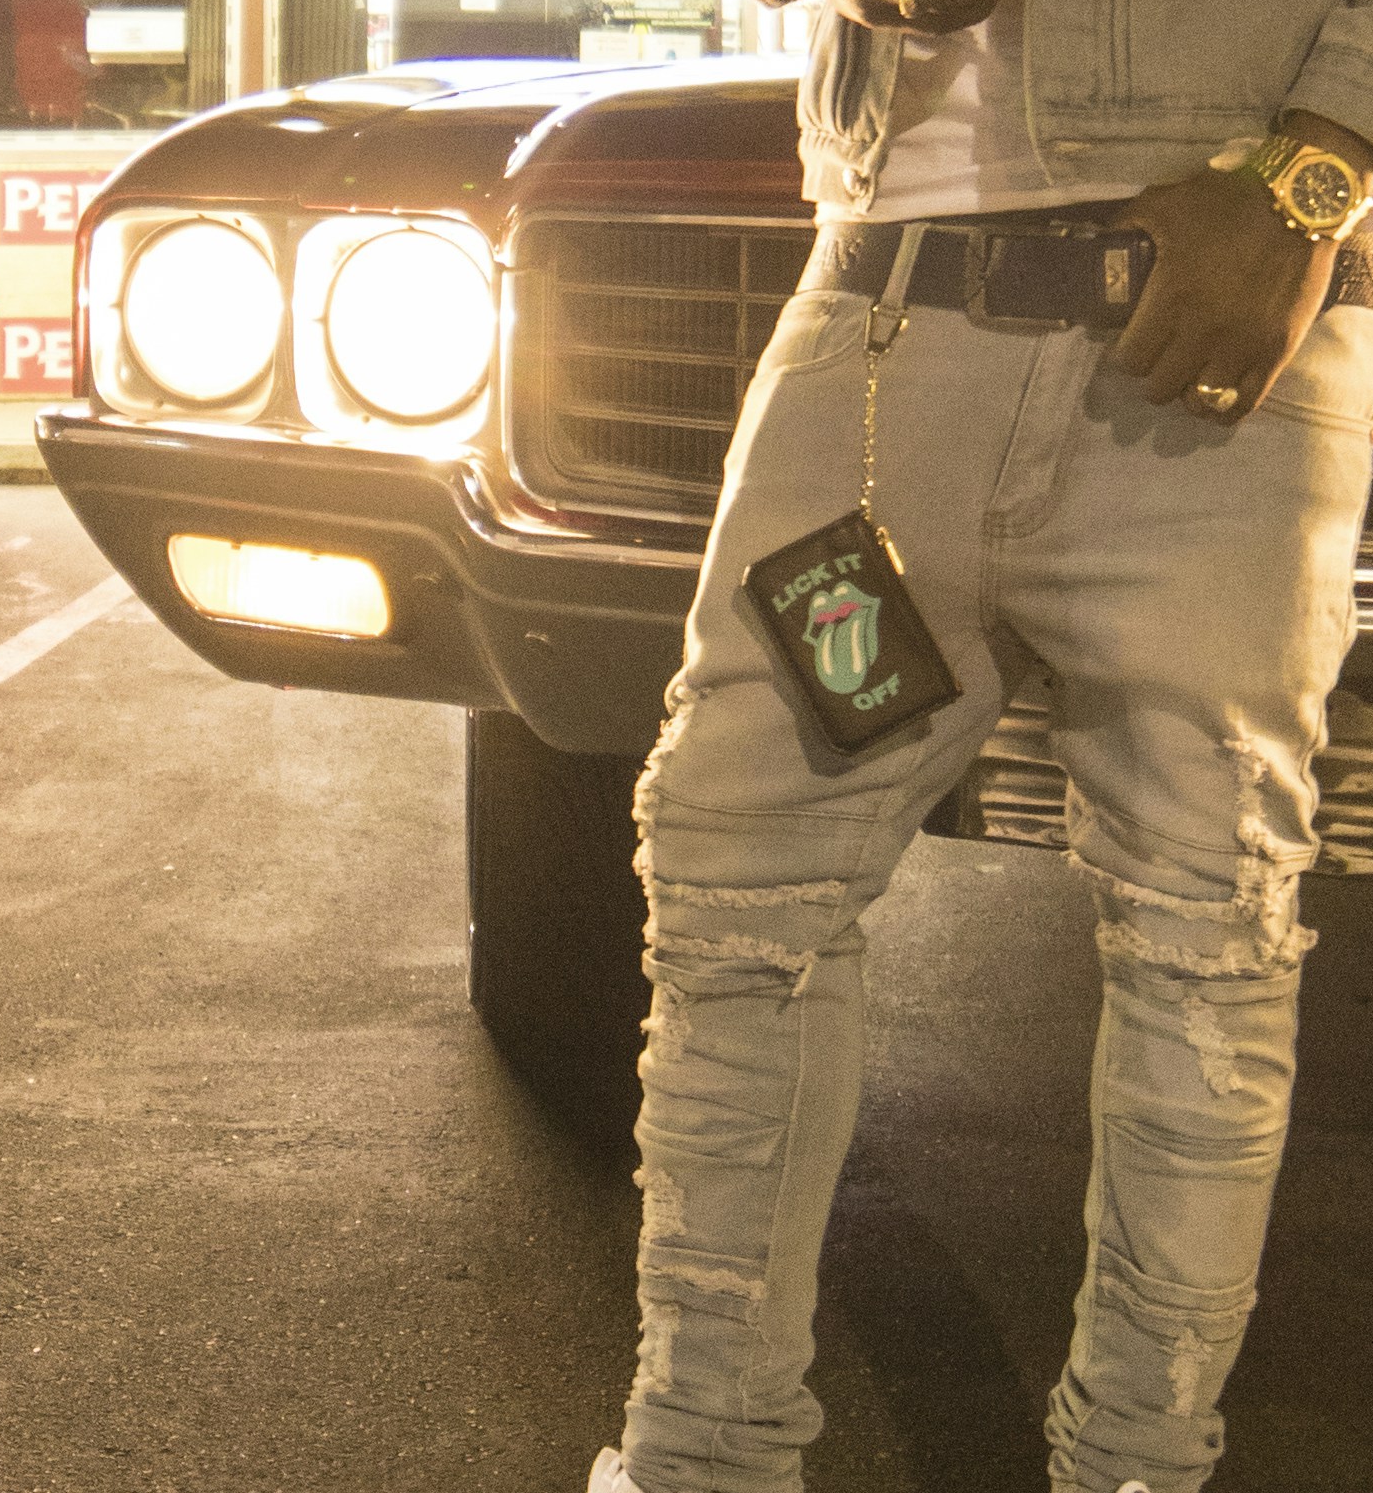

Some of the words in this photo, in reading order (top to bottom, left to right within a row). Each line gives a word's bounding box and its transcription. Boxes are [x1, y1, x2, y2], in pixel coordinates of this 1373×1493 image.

[772, 562, 833, 613] LICK
[834, 553, 861, 575] IT
[852, 673, 900, 711] OFF
